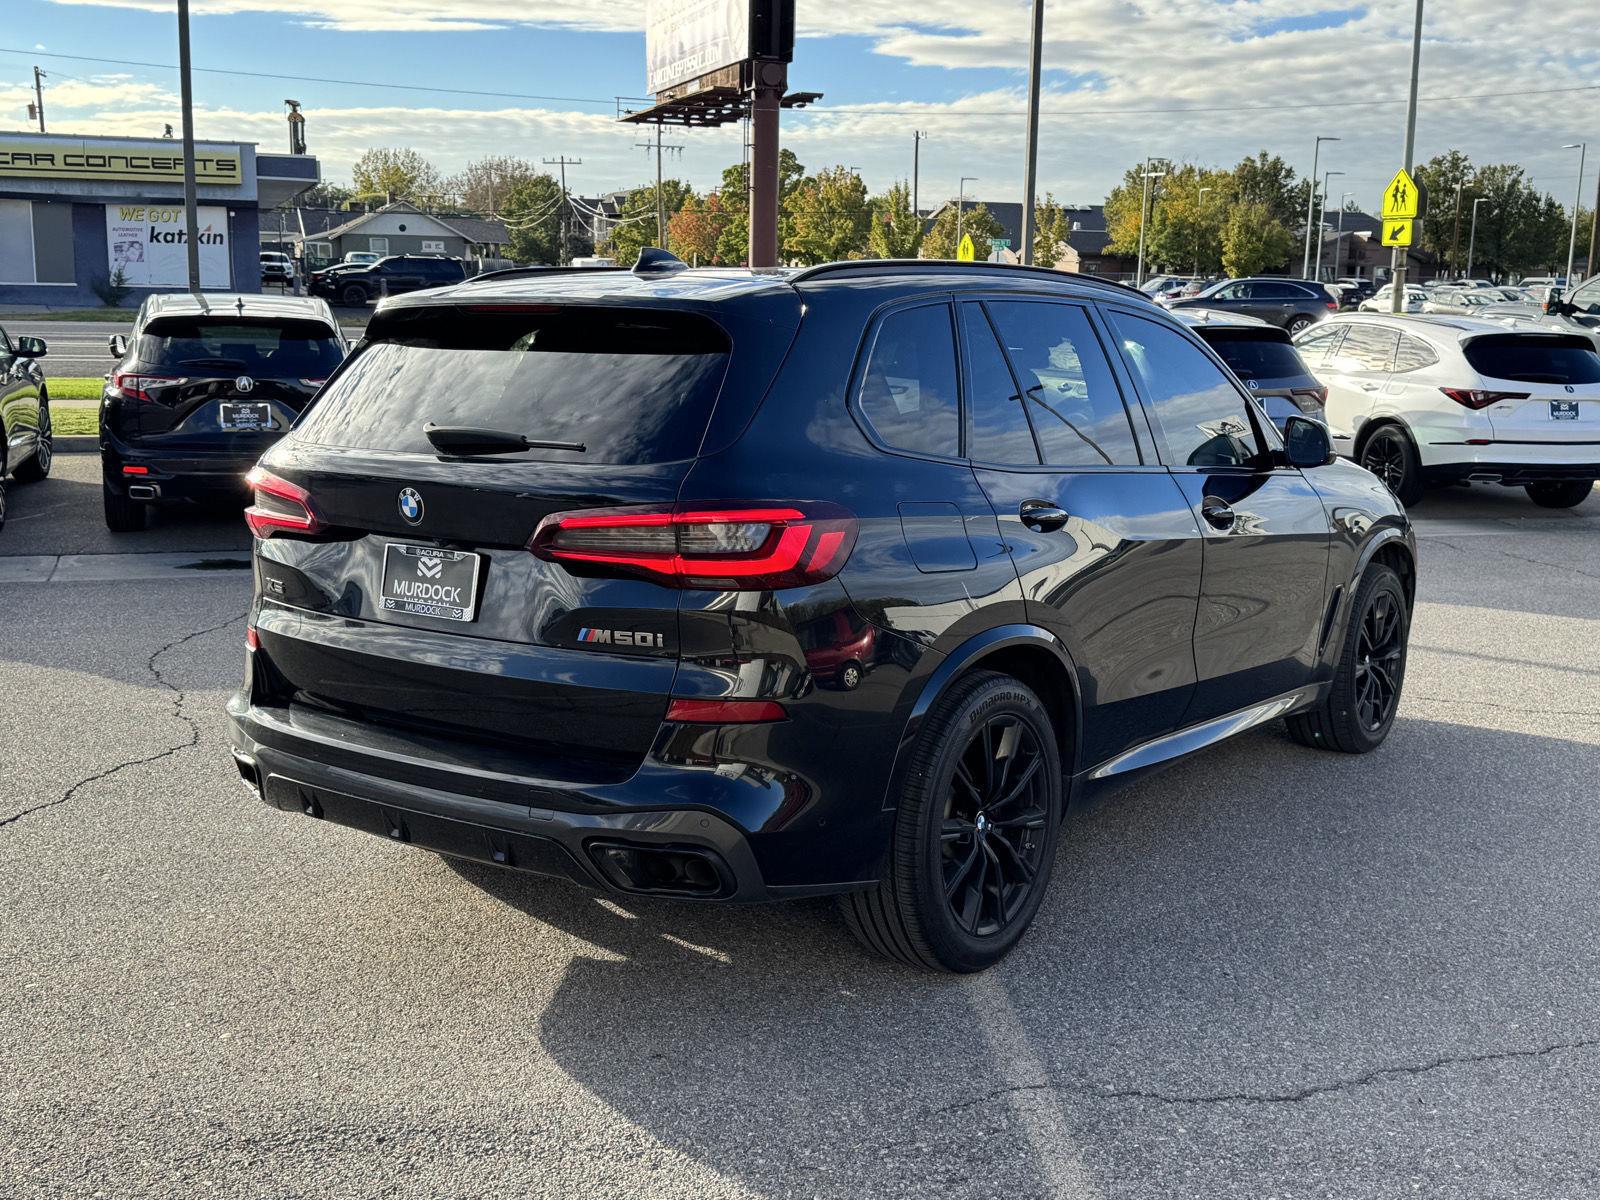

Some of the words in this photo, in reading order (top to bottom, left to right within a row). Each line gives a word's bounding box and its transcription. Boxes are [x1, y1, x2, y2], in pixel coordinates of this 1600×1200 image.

[120, 207, 145, 222] WE
[148, 208, 181, 223] GOT
[149, 225, 224, 245] katkin
[421, 549, 444, 558] ACURA
[393, 580, 461, 602] MURDOCK
[405, 602, 441, 615] MURDOCK
